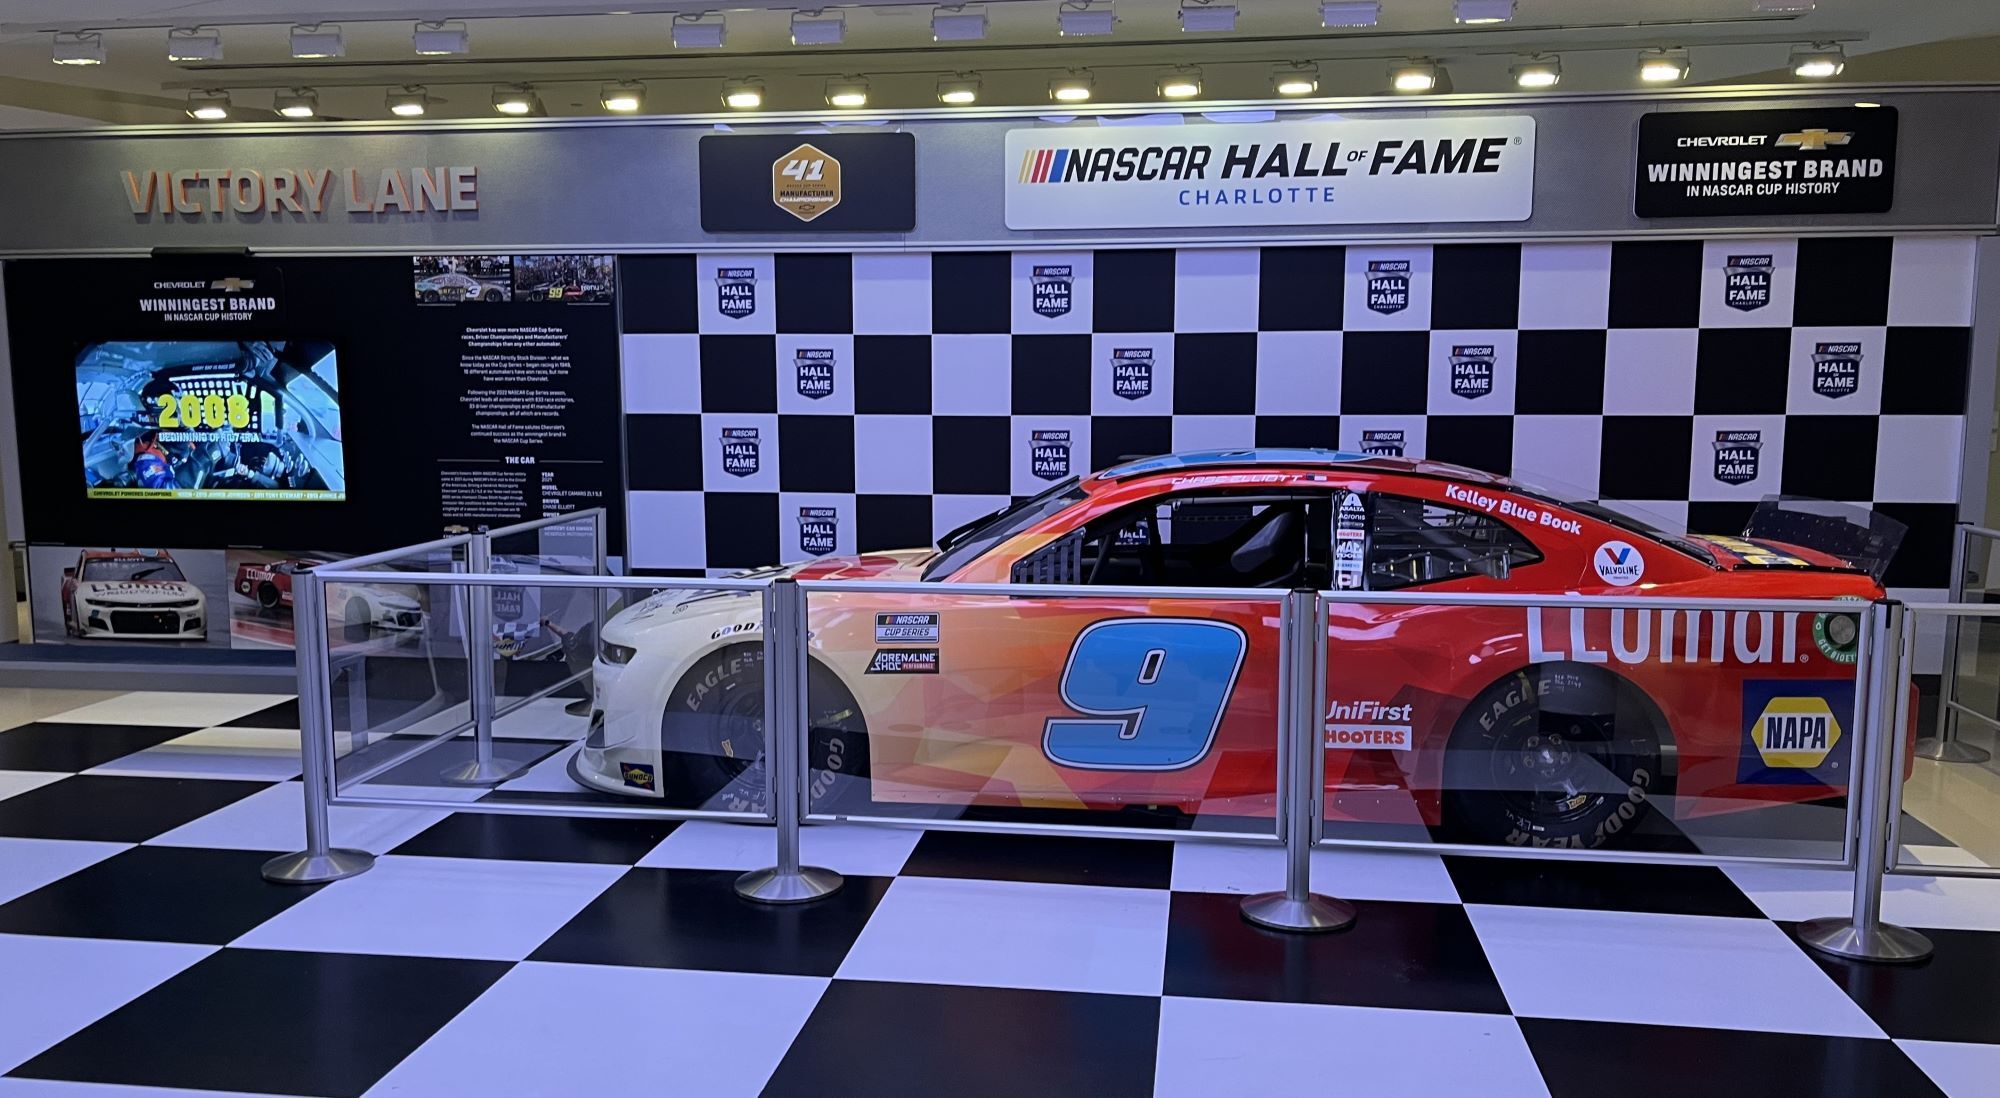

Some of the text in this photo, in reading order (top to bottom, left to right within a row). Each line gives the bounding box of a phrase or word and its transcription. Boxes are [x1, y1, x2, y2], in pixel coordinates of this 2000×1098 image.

[1677, 135, 1768, 148] CHEVROLET
[1063, 137, 1507, 183] NASCAR HALL OF FAME
[782, 159, 825, 181] 41
[1648, 159, 1883, 183] WINNINGEST BRAND
[119, 166, 479, 214] VICTORY LANE
[1686, 182, 1840, 197] IN NASCAR CUP HISTORY
[1179, 186, 1336, 206] CHARLOTTE
[153, 281, 206, 289] CHEVROLET
[1371, 280, 1405, 290] HALL
[1730, 275, 1767, 286] HALL
[548, 287, 563, 298] 99
[721, 285, 752, 296] HALL
[1036, 284, 1068, 294] HALL
[1371, 294, 1405, 304] FAME
[1729, 290, 1766, 300] FAME
[140, 297, 276, 311] WINNINGEST BRAND
[722, 299, 752, 309] FAME
[1036, 298, 1068, 308] FAME
[164, 312, 253, 321] IN NASCAR CUP HISTORY
[800, 367, 830, 376] HALL
[1117, 367, 1148, 376] HALL
[1455, 364, 1490, 374] HALL
[1818, 362, 1855, 372] HALL
[800, 380, 830, 390] FAME
[1117, 380, 1148, 390] FAME
[1455, 379, 1489, 389] FAME
[1817, 377, 1854, 387] FAME
[157, 393, 250, 429] 2008
[1374, 432, 1402, 440] NASCAR
[725, 445, 756, 455] HALL
[1035, 448, 1067, 458] HALL
[1719, 450, 1755, 460] HALL
[505, 456, 536, 464] THE CAR
[726, 458, 757, 468] FAME
[1035, 462, 1067, 471] FAME
[1718, 464, 1755, 475] FAME
[1171, 474, 1303, 485] CHASE ELLIOTT
[1445, 484, 1583, 535] Kelley Blue Book
[1338, 512, 1366, 520] Acronis
[803, 524, 833, 534] HALL
[803, 537, 834, 547] FAME
[1599, 564, 1639, 576] VALVOLINE
[896, 616, 930, 624] NASCAR
[884, 628, 930, 636] CUP SERIES
[875, 652, 936, 662] ADRENALINE
[870, 662, 902, 671] SHOC
[686, 657, 742, 712] EAGLE
[1041, 616, 1249, 773] 9
[1325, 730, 1404, 745] HOOTERS
[1766, 717, 1826, 749] NAPA
[624, 771, 653, 783] SUNOCO
